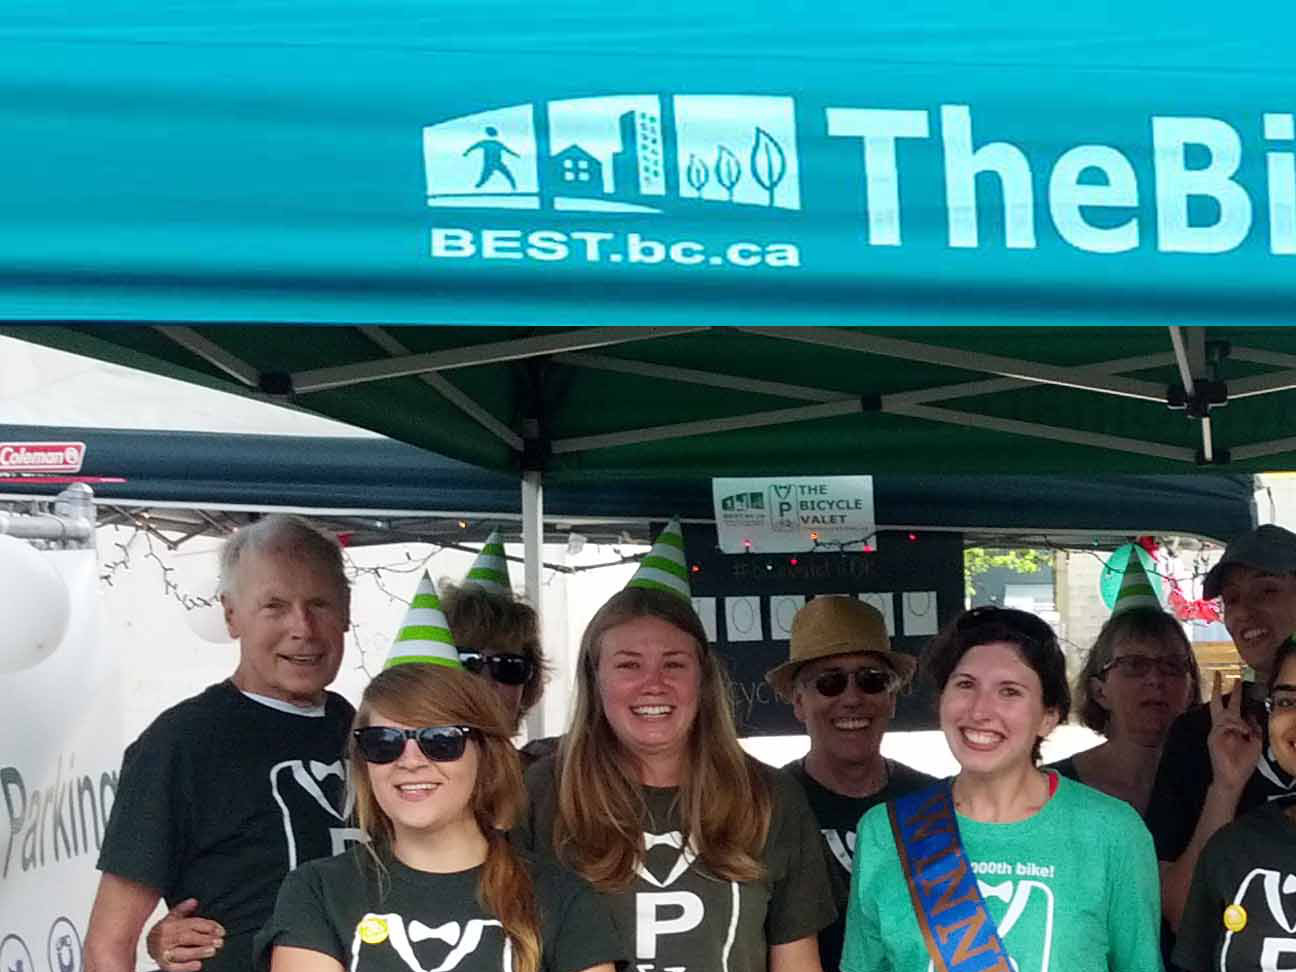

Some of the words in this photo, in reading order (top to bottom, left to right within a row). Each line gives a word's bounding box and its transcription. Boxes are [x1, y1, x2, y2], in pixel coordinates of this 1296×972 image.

[430, 227, 801, 268] BEST.bc.ca
[0, 447, 65, 465] Coleman
[799, 484, 828, 495] THE
[778, 502, 792, 517] P
[799, 499, 863, 511] BICYCLE
[800, 514, 848, 525] VALET
[1015, 862, 1055, 878] bike!
[636, 890, 705, 960] P
